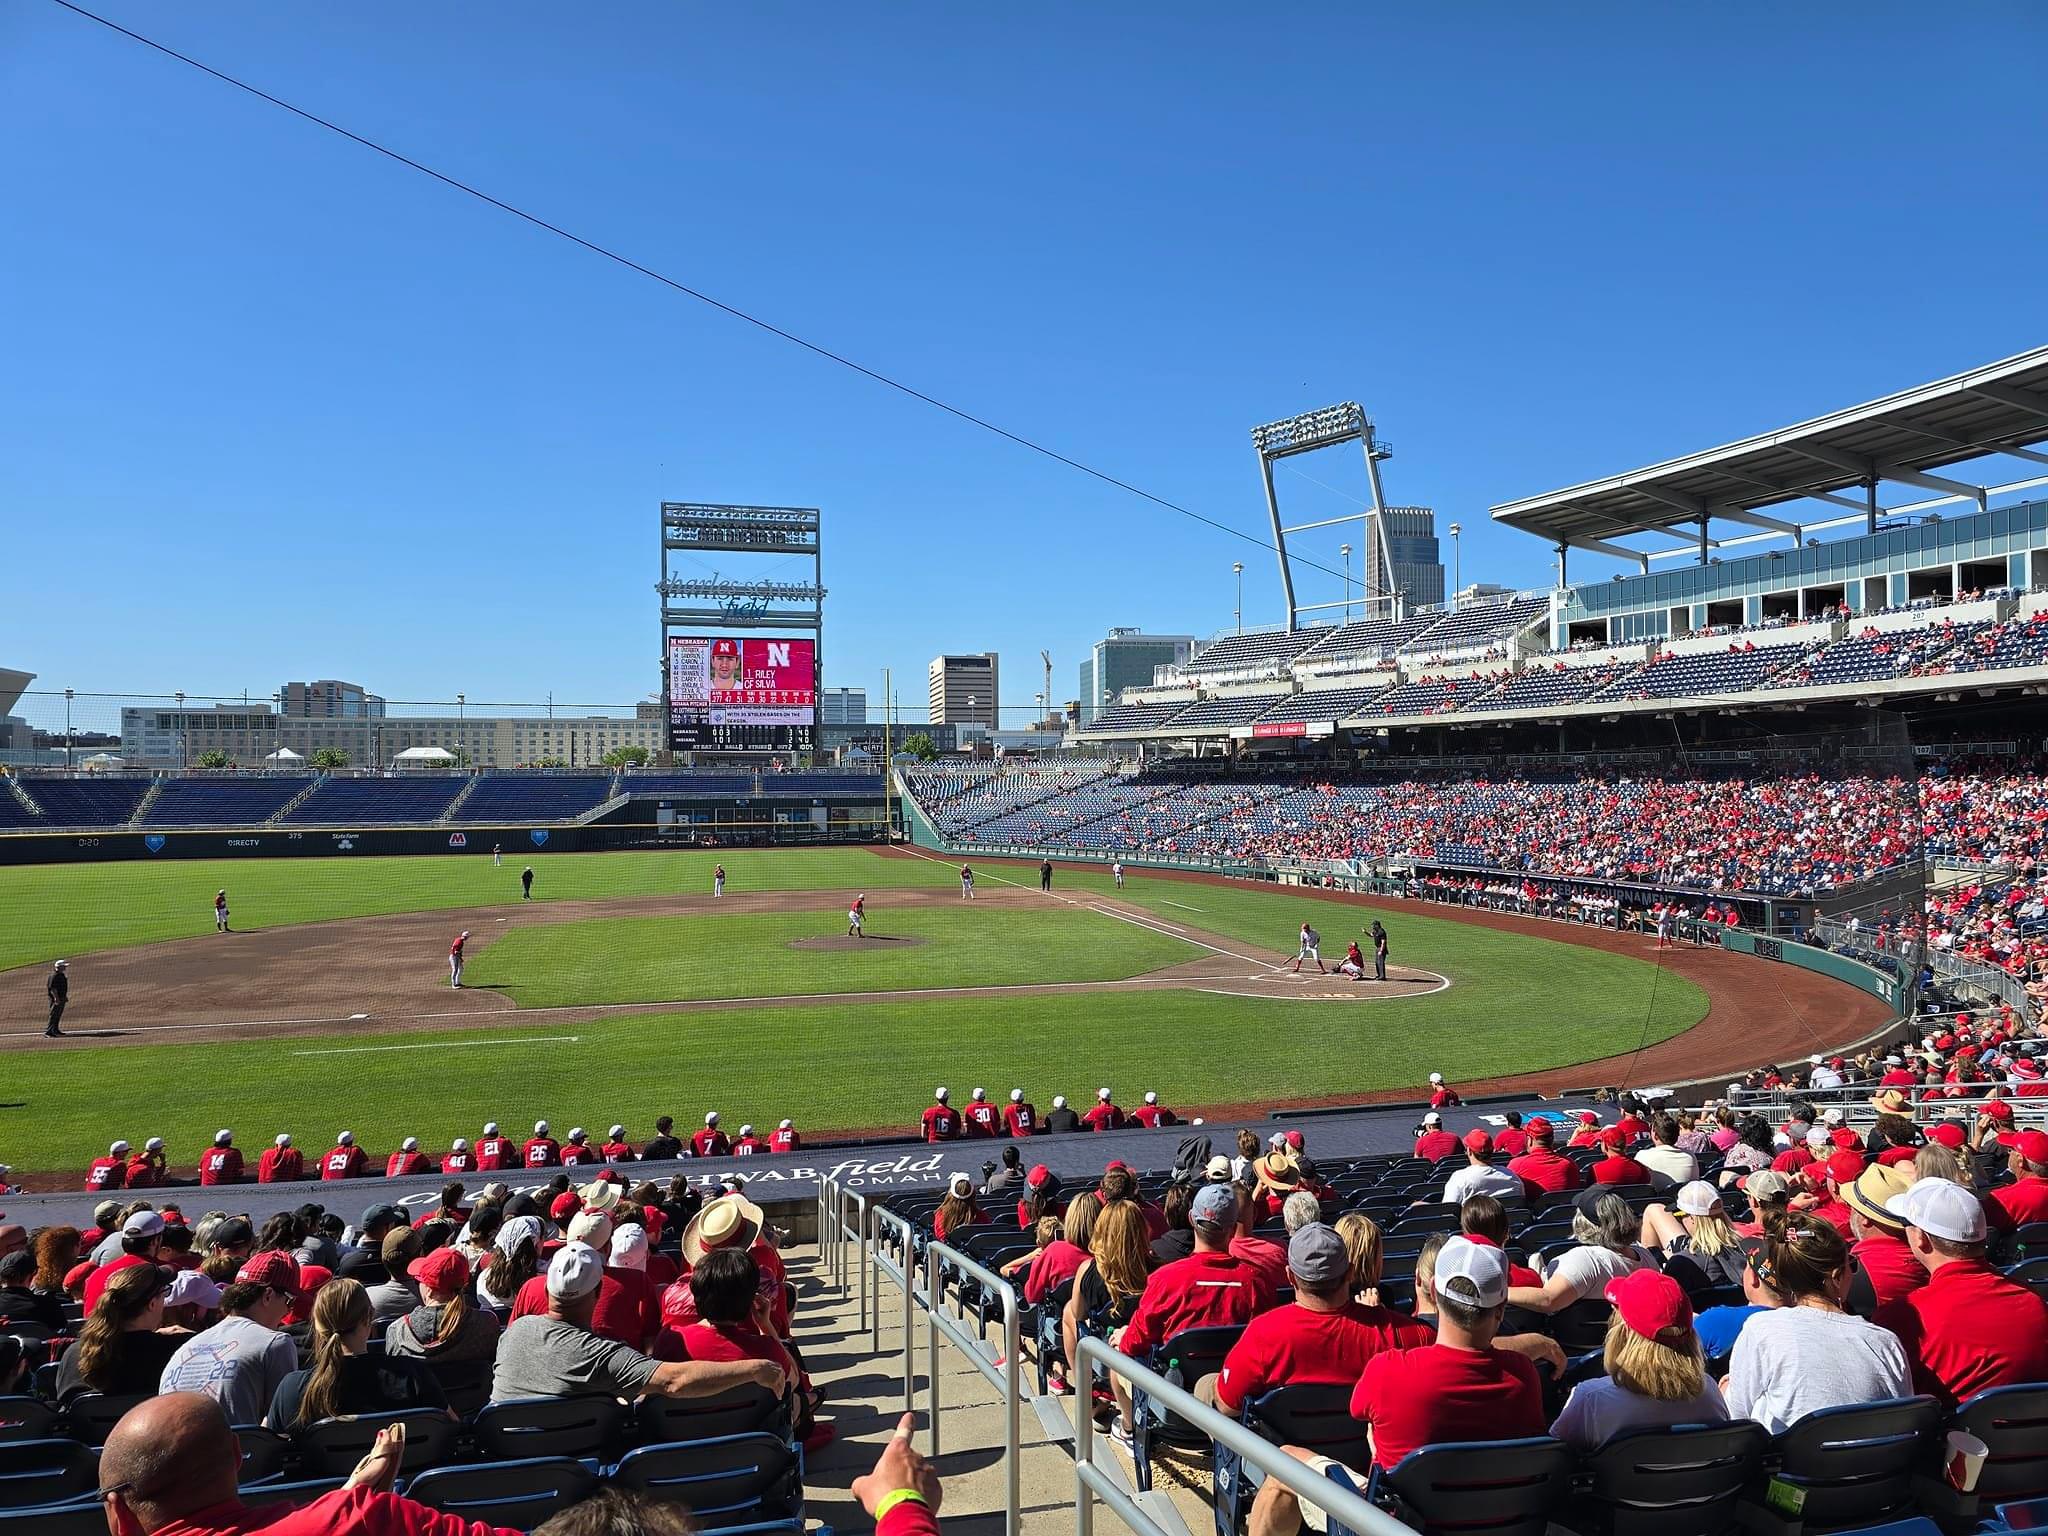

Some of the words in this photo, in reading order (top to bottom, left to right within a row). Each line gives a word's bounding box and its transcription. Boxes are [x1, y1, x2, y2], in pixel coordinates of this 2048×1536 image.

[768, 643, 790, 667] N
[755, 669, 776, 678] RILEY
[744, 680, 754, 688] CF
[755, 680, 776, 688] SILVA
[79, 838, 99, 847] 0:20
[227, 839, 260, 847] DIRECTV
[1593, 888, 1677, 906] TOURNAMENT
[974, 1108, 990, 1123] 30
[1107, 1114, 1113, 1129] 1
[936, 1117, 949, 1132] 16
[777, 1131, 792, 1143] 12
[484, 1142, 499, 1155] 21
[530, 1145, 547, 1161] 26
[704, 1139, 713, 1155] 7
[738, 1145, 753, 1156] 10
[208, 1154, 225, 1170] 14
[329, 1154, 347, 1170] 29
[449, 1155, 466, 1168] 40
[815, 1153, 944, 1183] field
[90, 1166, 111, 1184] 55
